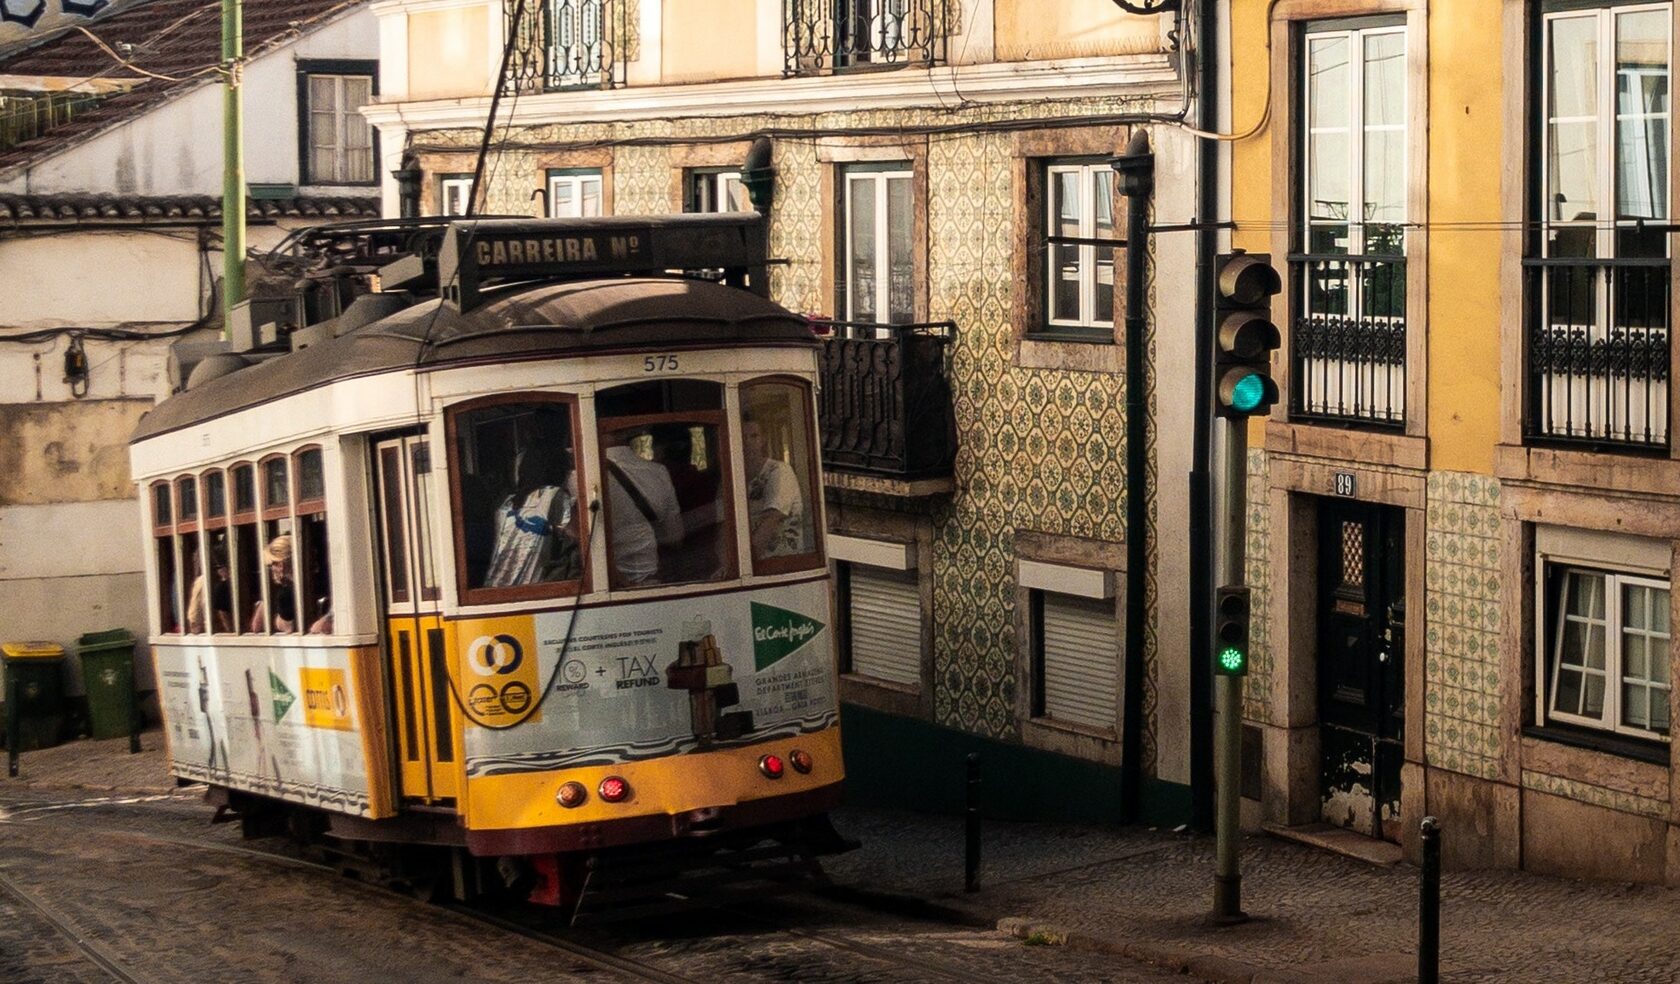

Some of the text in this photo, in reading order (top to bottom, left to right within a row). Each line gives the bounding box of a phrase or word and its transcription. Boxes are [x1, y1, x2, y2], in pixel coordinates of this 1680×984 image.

[476, 238, 598, 265] CARREIRA
[644, 354, 678, 371] 575
[1338, 474, 1351, 495] 89
[615, 653, 659, 680] TAX
[556, 676, 660, 692] REWARD REFUND
